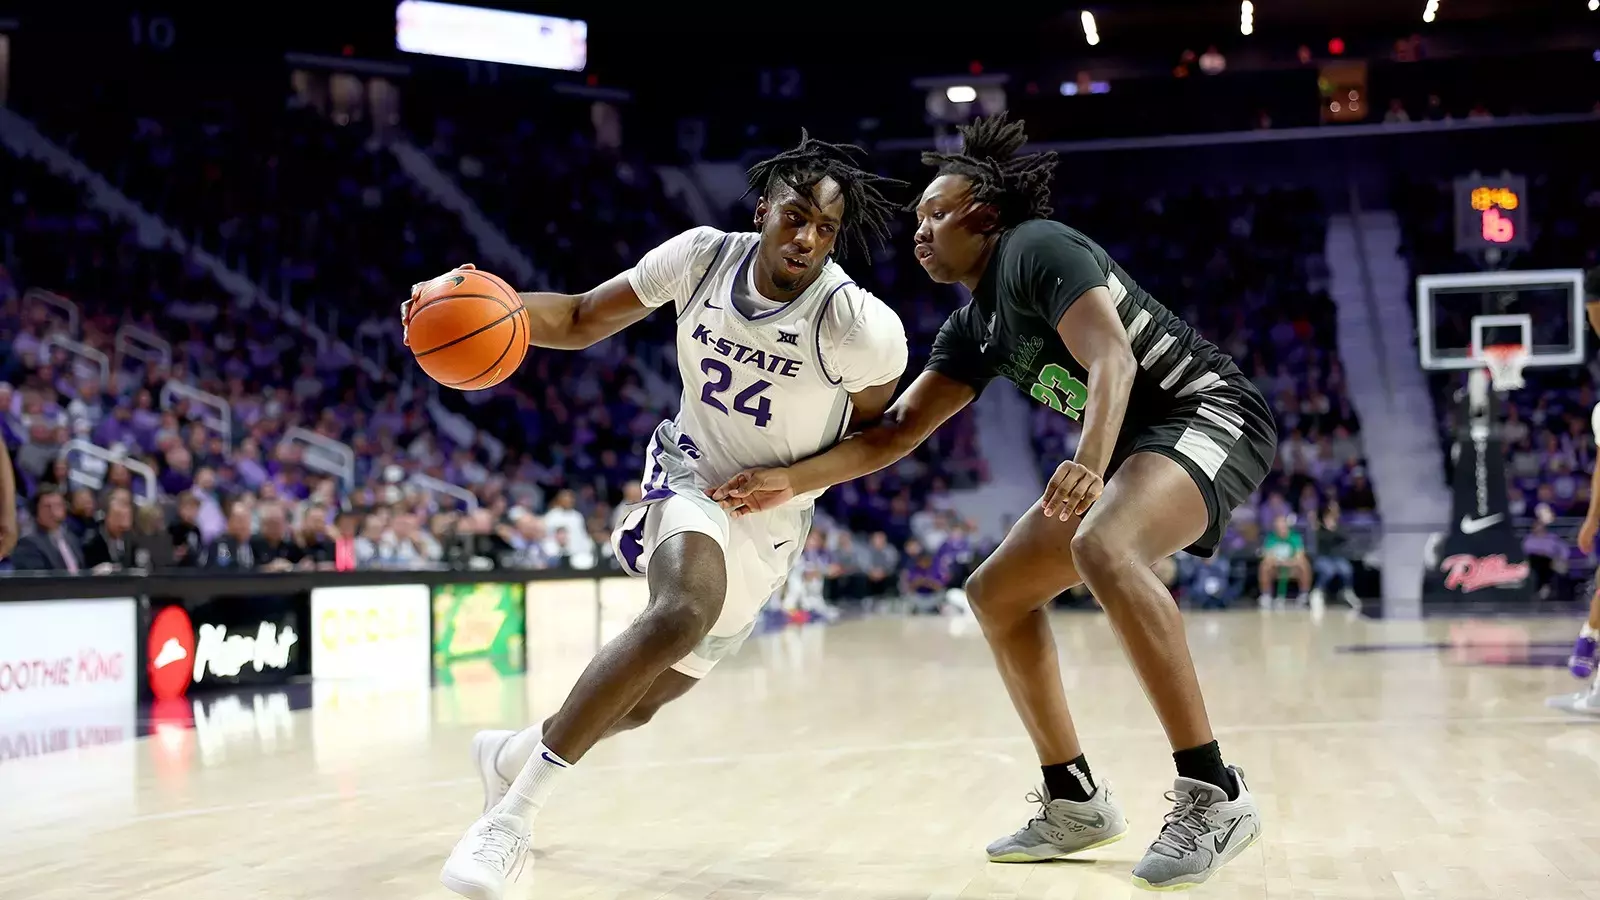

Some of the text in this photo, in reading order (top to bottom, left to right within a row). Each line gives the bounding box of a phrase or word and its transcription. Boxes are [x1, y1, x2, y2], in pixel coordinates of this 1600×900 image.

[130, 16, 176, 49] 10
[691, 323, 803, 378] K-STATE
[700, 357, 773, 428] 24
